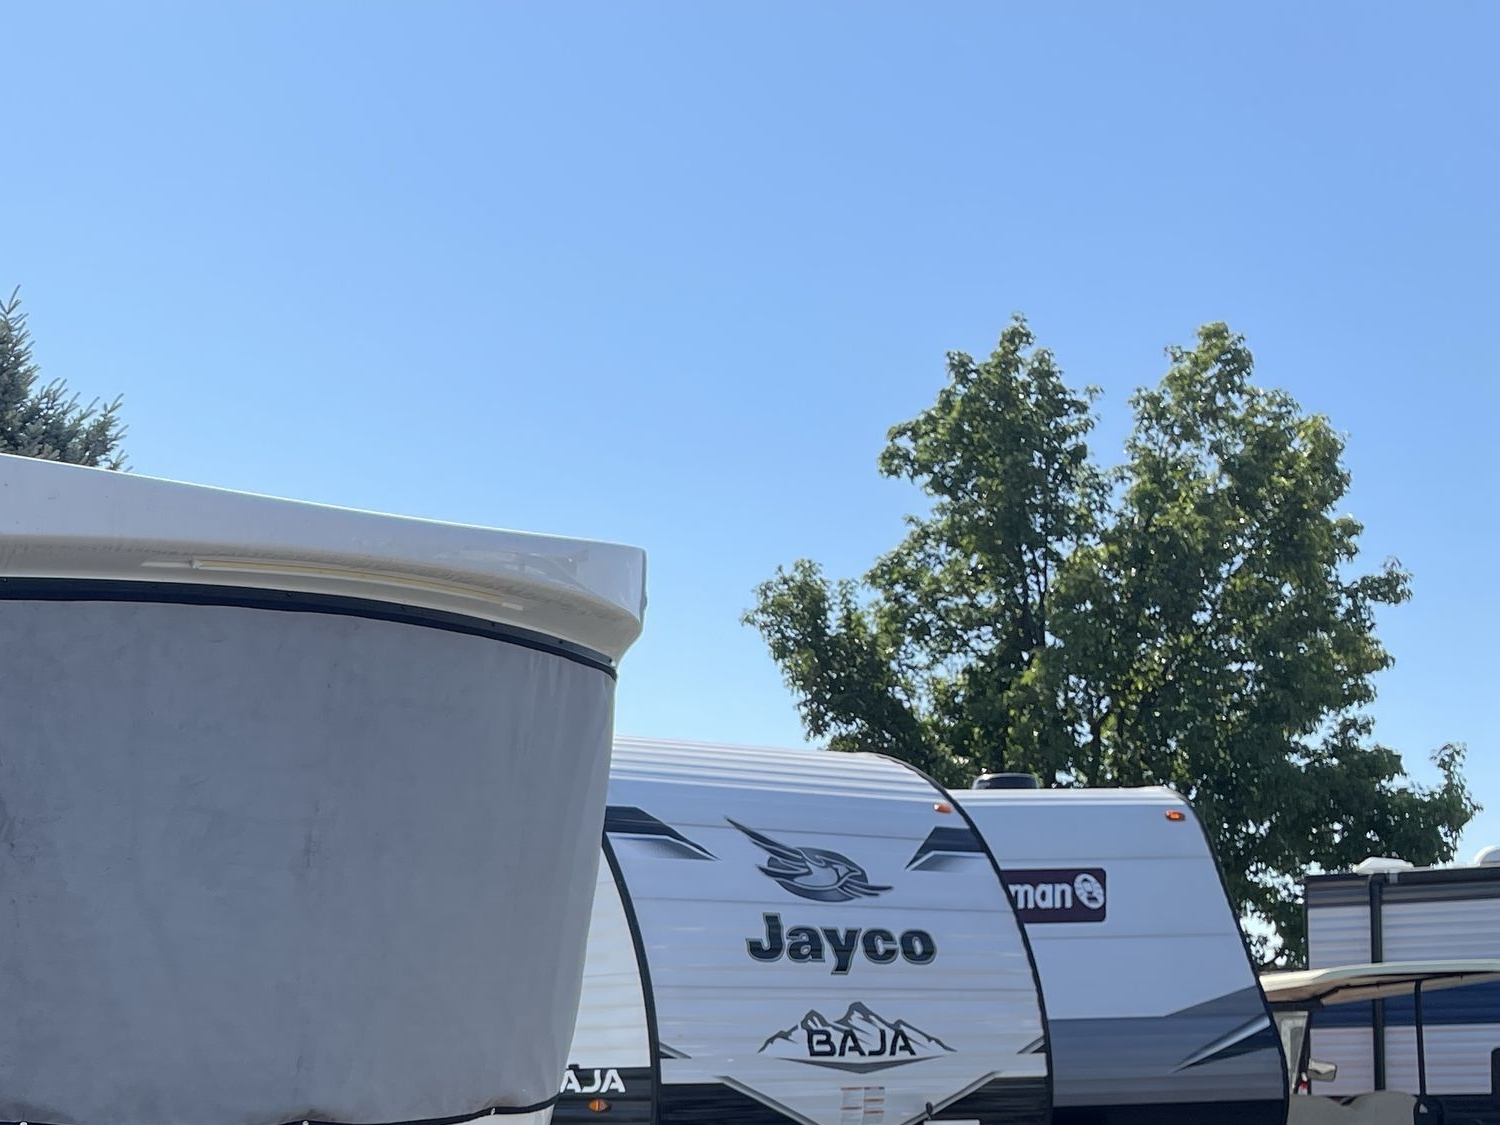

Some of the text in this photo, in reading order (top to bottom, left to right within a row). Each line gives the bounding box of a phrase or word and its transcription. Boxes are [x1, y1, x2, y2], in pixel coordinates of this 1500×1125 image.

[746, 912, 938, 976] Jayco
[806, 1019, 917, 1057] BAJA
[560, 1069, 626, 1093] AJA
